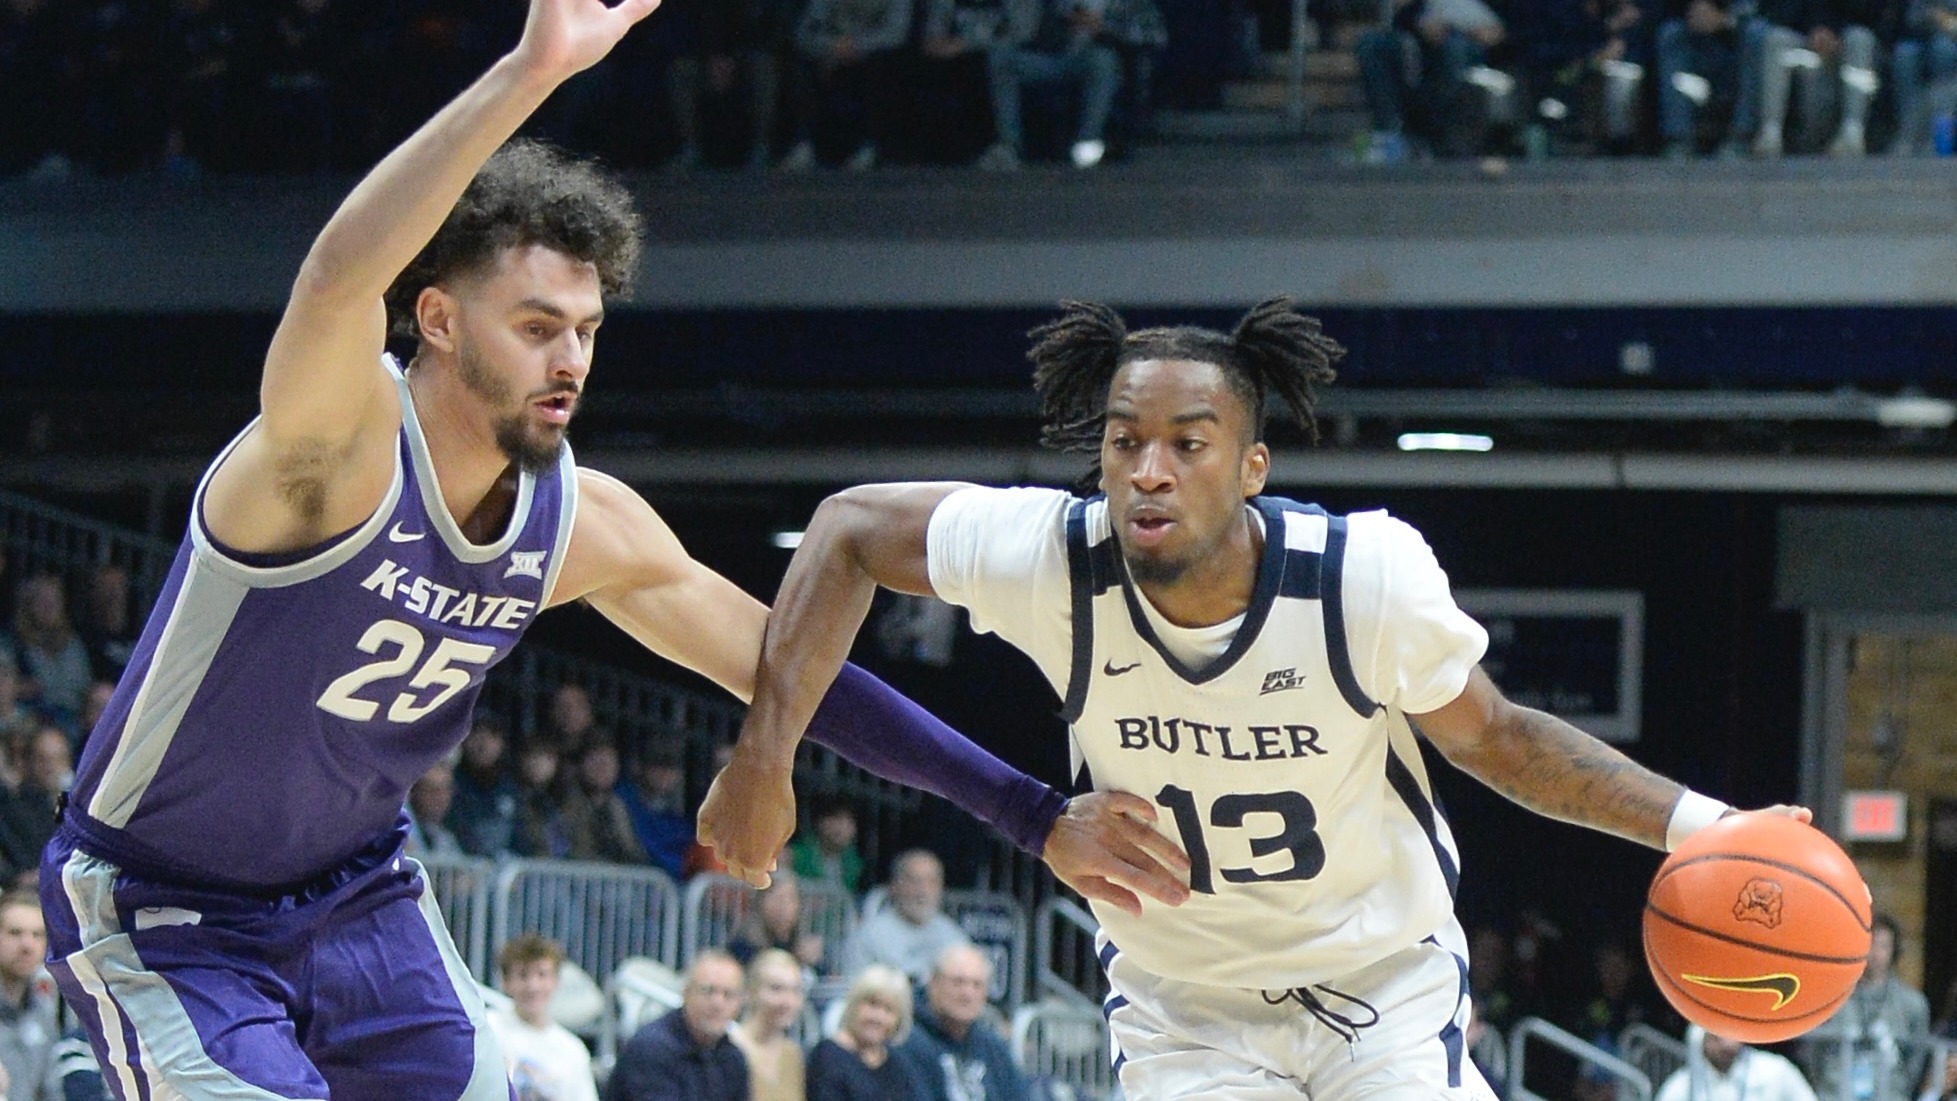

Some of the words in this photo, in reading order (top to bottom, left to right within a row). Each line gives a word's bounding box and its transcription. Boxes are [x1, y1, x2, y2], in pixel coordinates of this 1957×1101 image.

[360, 558, 536, 630] K-STATE
[316, 618, 496, 724] 25
[1261, 675, 1307, 692] EAST
[1265, 667, 1297, 681] BIG
[1114, 715, 1328, 761] BUTLER
[1155, 783, 1326, 894] 13
